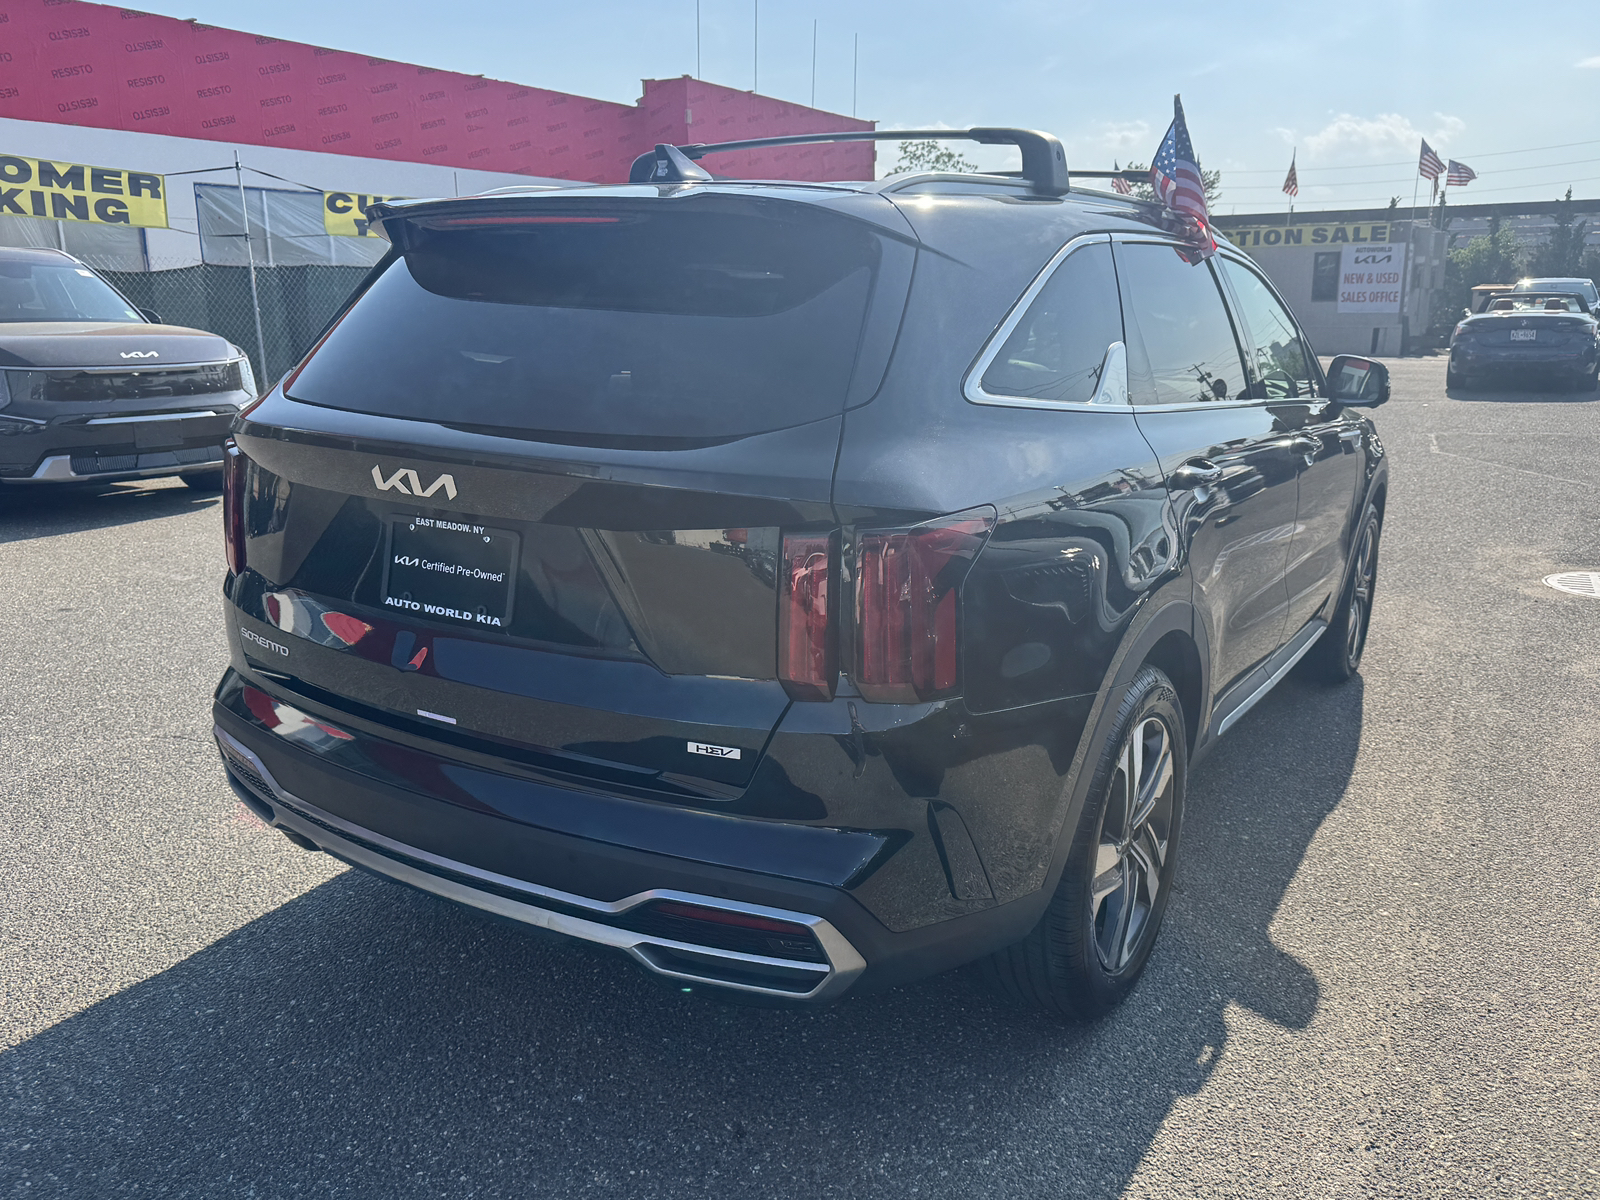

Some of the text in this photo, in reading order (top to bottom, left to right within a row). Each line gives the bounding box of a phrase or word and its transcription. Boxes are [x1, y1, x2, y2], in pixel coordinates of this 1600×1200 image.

[48, 27, 91, 41] RESISTO
[124, 39, 163, 53] RESISTO
[194, 51, 230, 65] RESISTO
[51, 64, 93, 80] RESISTO
[258, 62, 291, 76] RESISTO
[126, 74, 166, 89] RESISTO
[316, 73, 347, 86] RESISTO
[196, 85, 232, 99] RESISTO
[371, 82, 399, 95] RESISTO
[260, 95, 292, 109] RESISTO
[420, 91, 446, 103] RESISTO
[57, 97, 99, 113] RESISTO
[317, 104, 348, 118] RESISTO
[132, 105, 171, 121] RESISTO
[371, 111, 399, 125] RESISTO
[465, 108, 489, 120] RESISTO
[201, 115, 237, 130] RESISTO
[420, 118, 446, 131] RESISTO
[264, 124, 296, 138] RESISTO
[322, 131, 351, 145] RESISTO
[374, 138, 402, 151] RESISTO
[422, 144, 448, 157] RESISTO
[0, 156, 162, 200] OMER
[0, 187, 130, 224] KING
[1311, 225, 1388, 244] SALE
[1354, 254, 1392, 264] KIA
[1343, 272, 1399, 284] NEW & USED
[1340, 291, 1399, 303] SALES OFFICE
[371, 464, 458, 501] KIA
[415, 517, 435, 528] EAST
[473, 525, 485, 535] NY
[394, 555, 420, 567] KIA
[421, 559, 455, 574] Certified
[385, 597, 502, 627] AUTO WORLD KIA
[241, 626, 290, 657] SORENTO
[696, 745, 734, 756] HEV
